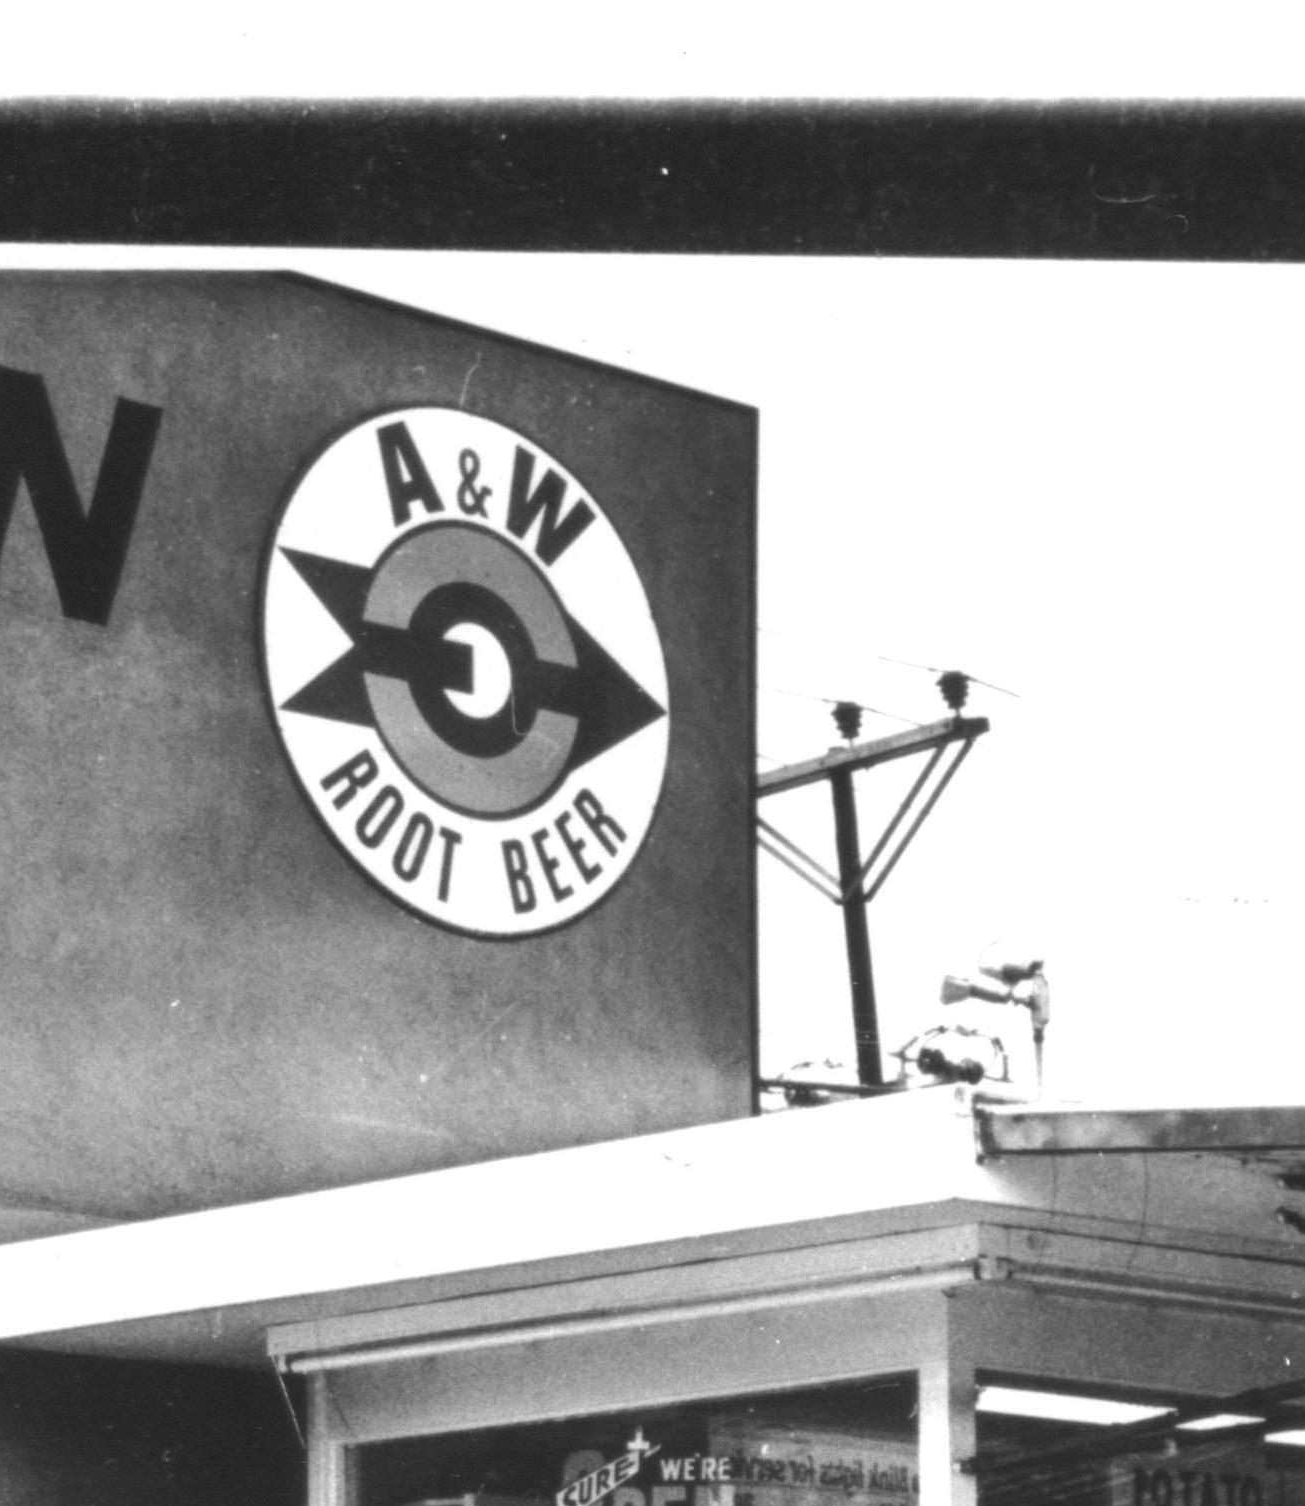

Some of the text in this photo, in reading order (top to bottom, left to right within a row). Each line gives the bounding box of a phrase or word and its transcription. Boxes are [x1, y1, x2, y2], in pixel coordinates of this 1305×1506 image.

[320, 748, 627, 914] ROOT BEER
[660, 1454, 732, 1481] WE'RE
